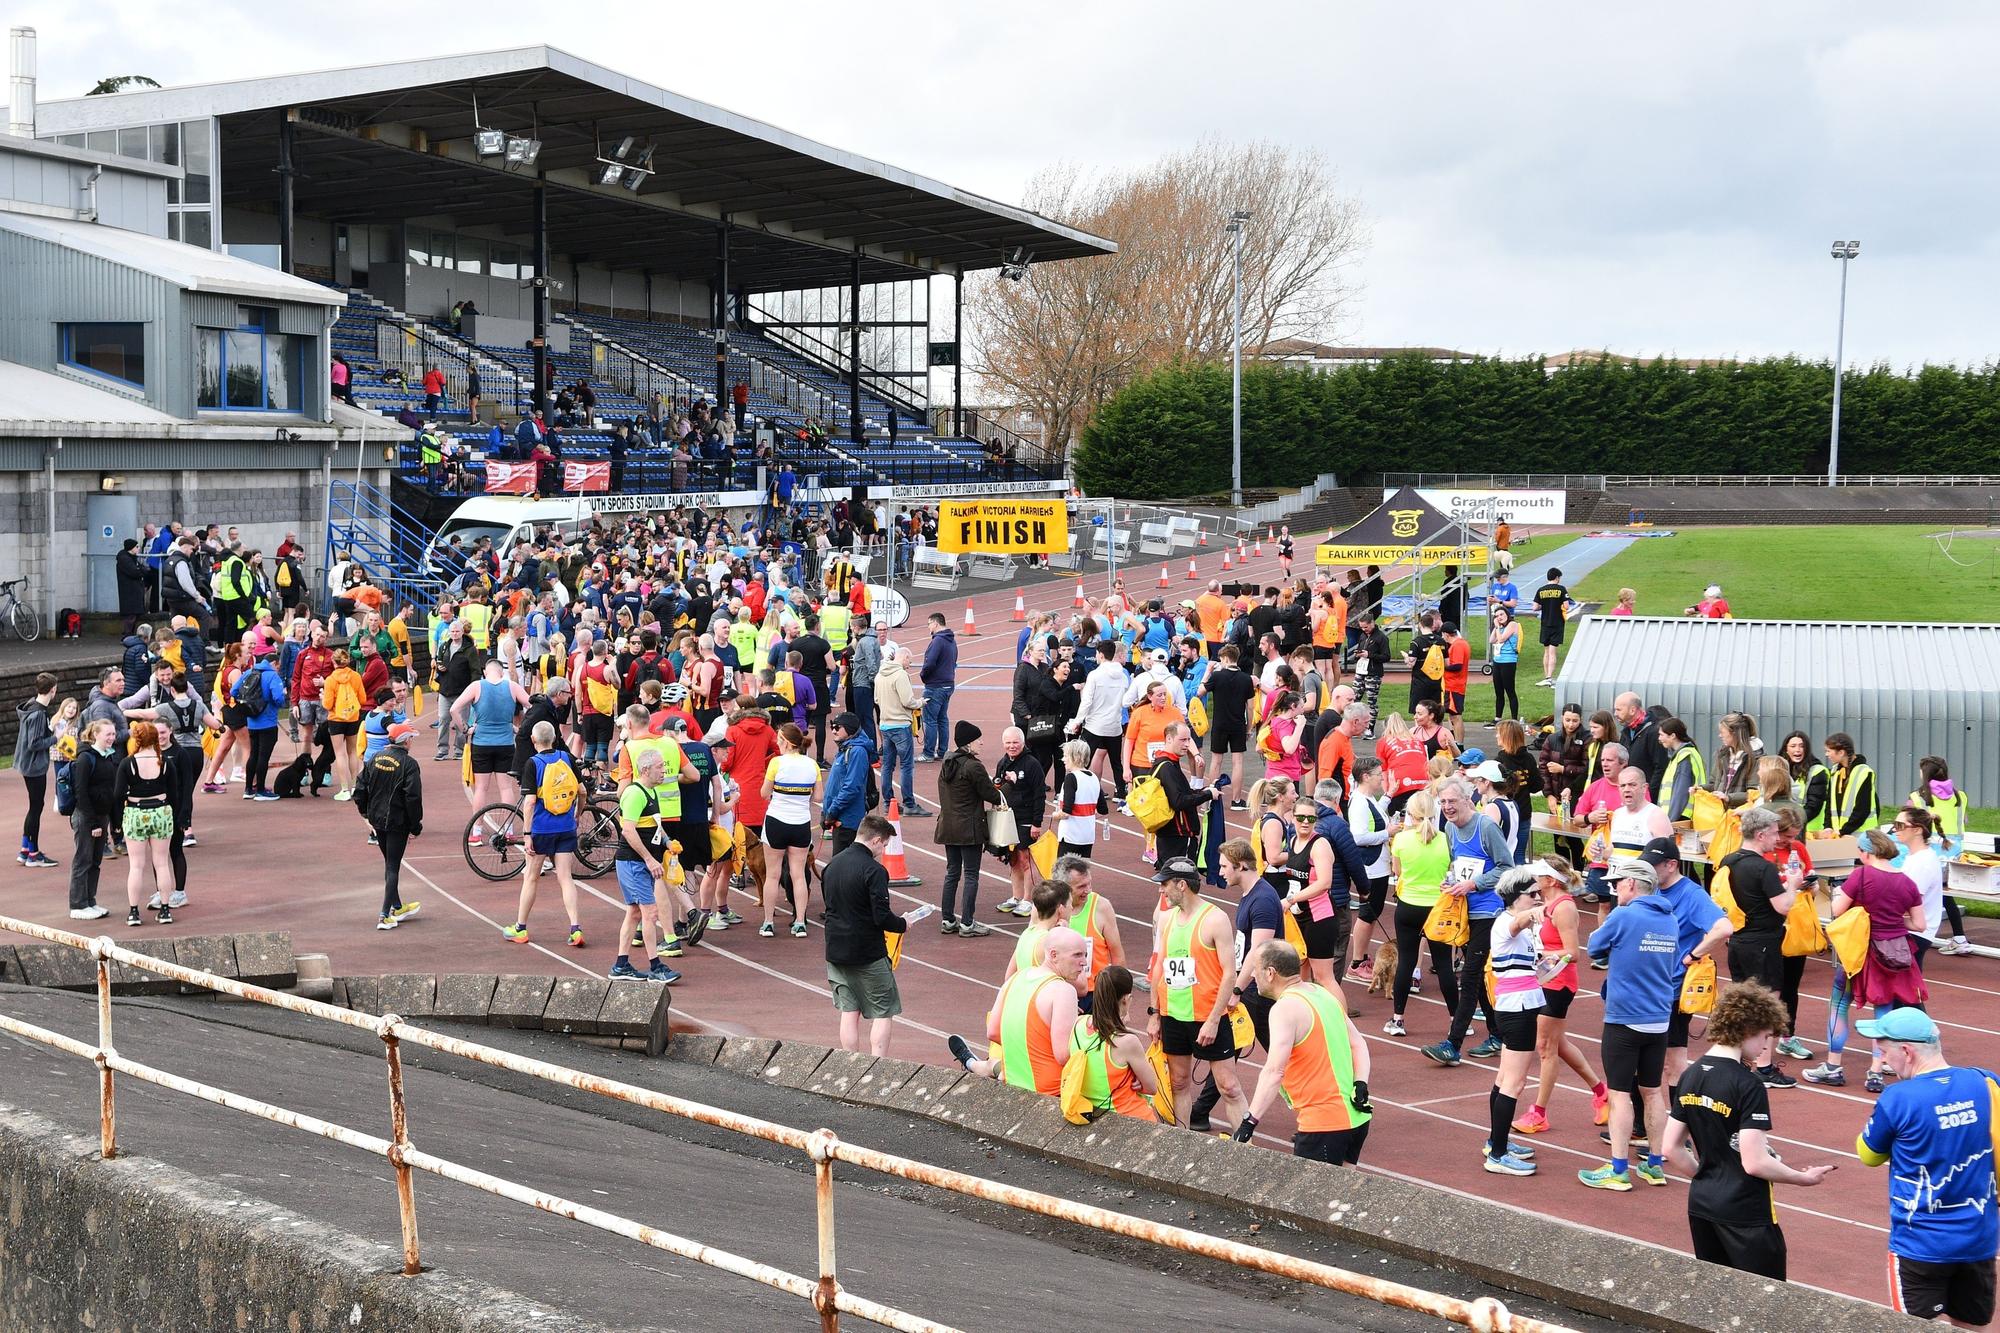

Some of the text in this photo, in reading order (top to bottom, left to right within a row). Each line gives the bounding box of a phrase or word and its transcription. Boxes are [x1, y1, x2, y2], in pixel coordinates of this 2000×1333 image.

[608, 496, 635, 510] SPORTS
[636, 495, 666, 509] STADIUM
[668, 494, 693, 508] FALKIRK
[695, 493, 720, 506] COUNCIL
[1451, 496, 1554, 507] Graemouth
[950, 505, 1054, 517] FALKIRK VICTORIA HARRIERS
[961, 520, 1046, 545] FINISH
[1328, 550, 1371, 559] FALKIRK
[1460, 867, 1474, 881] 47
[1169, 960, 1186, 976] 94
[1934, 1100, 1975, 1115] finisher
[1938, 1109, 1978, 1130] 2023
